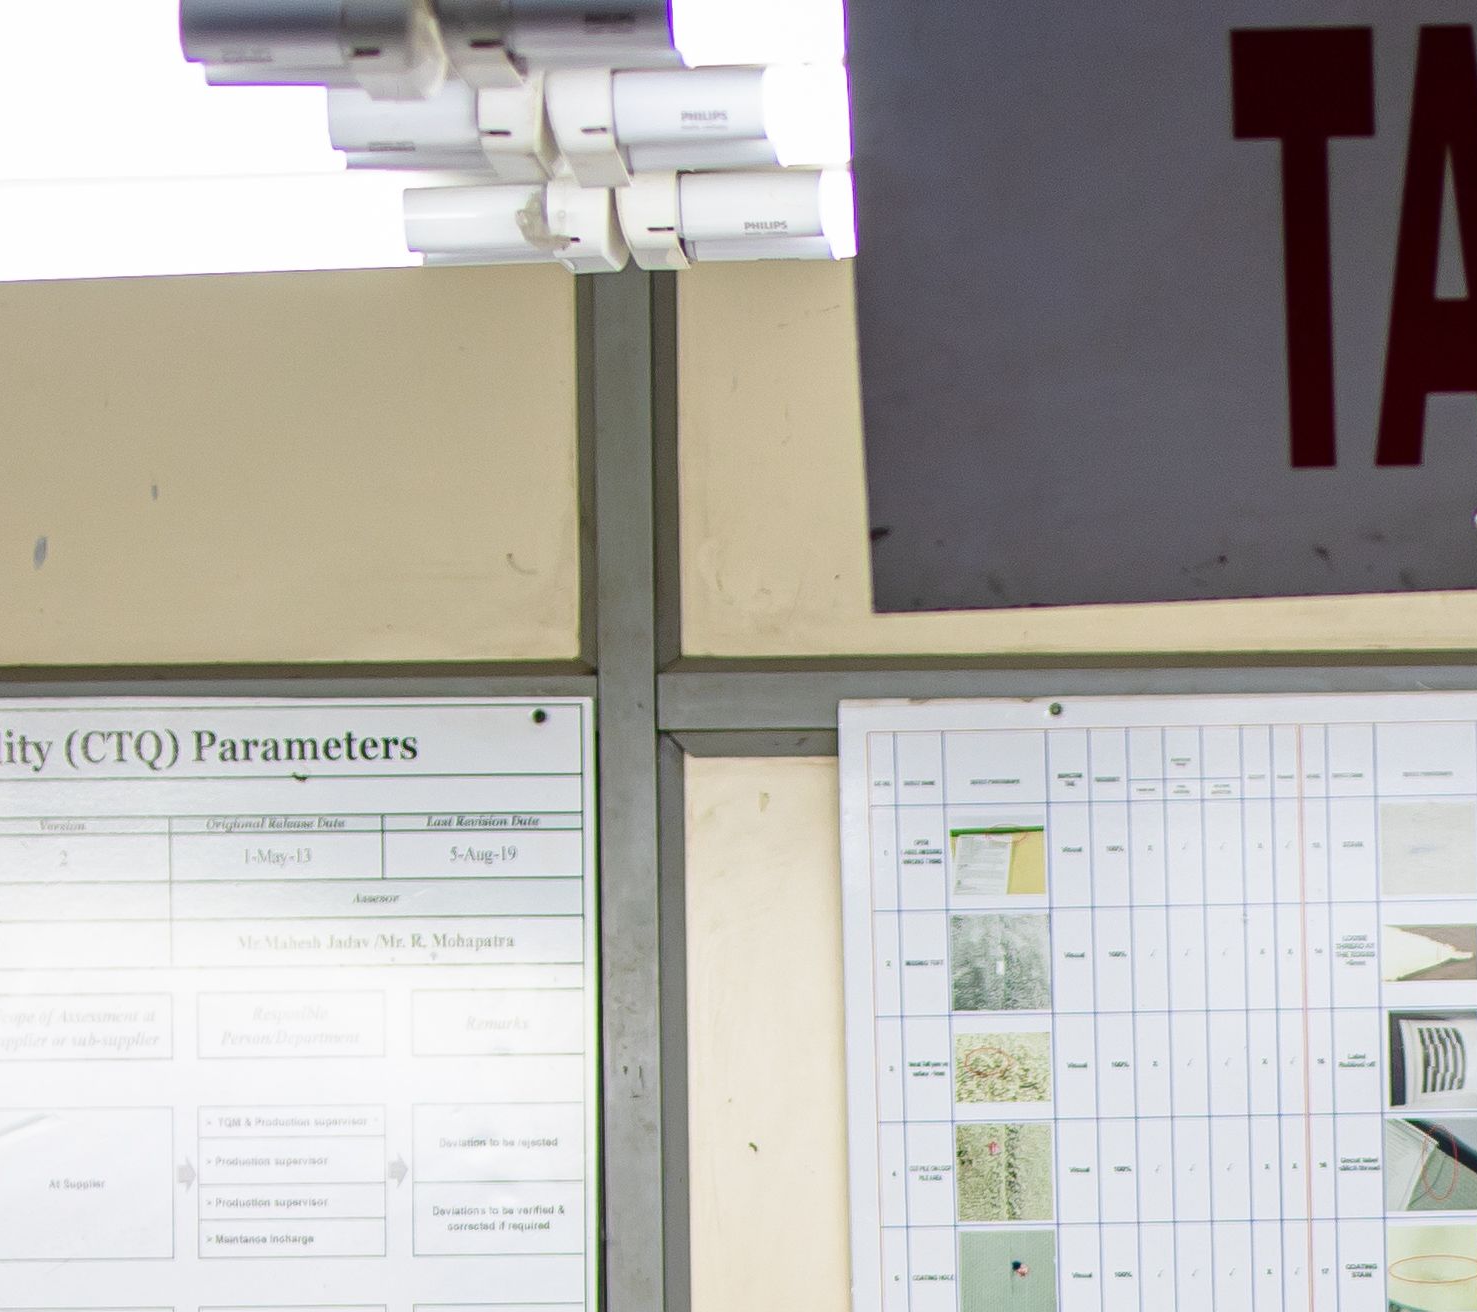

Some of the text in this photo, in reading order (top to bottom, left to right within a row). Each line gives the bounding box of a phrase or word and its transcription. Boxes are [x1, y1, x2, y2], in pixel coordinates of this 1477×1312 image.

[65, 729, 179, 770] (CTQ)
[193, 729, 418, 763] Parameters
[244, 848, 312, 868] 1-May-13
[450, 846, 517, 866] 5-Aug-19
